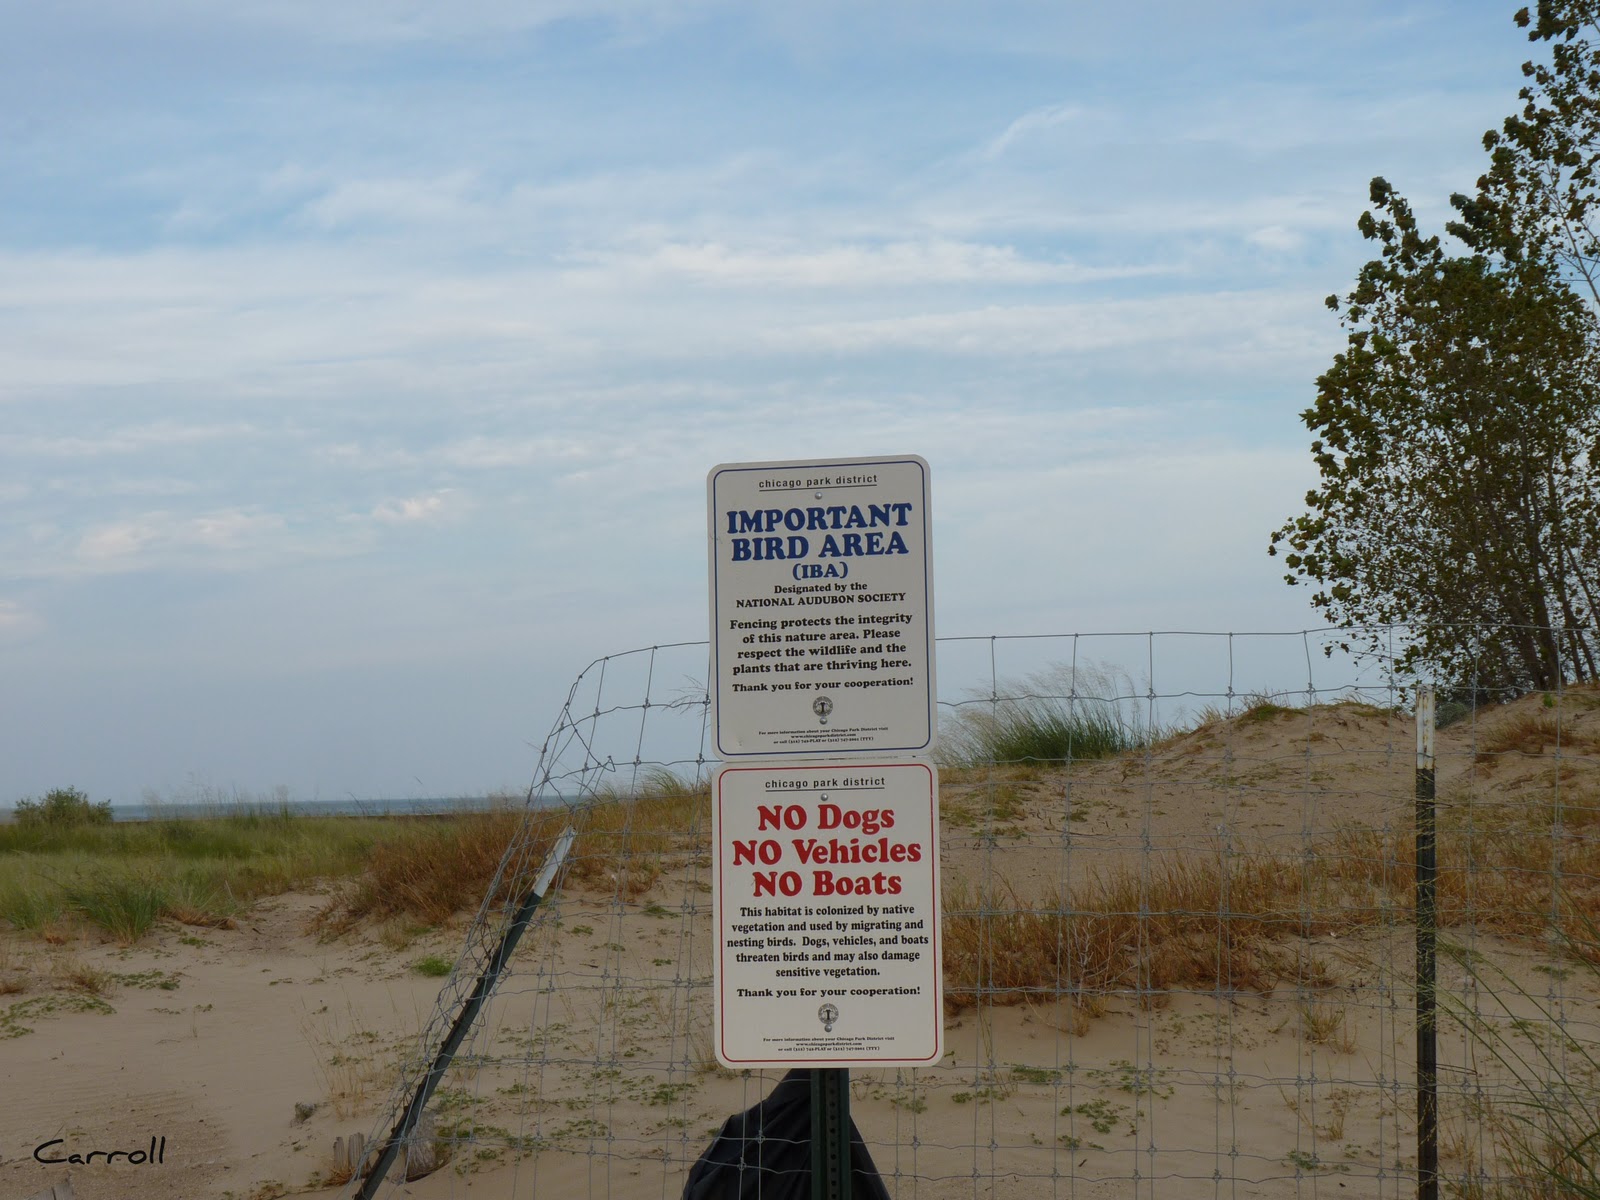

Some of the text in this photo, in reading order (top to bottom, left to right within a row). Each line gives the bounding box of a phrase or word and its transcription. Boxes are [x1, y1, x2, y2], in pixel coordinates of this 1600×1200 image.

[759, 475, 877, 489] chicago park district
[726, 502, 912, 534] IMPORTANT
[732, 531, 909, 561] BIRD AREA
[792, 561, 848, 580] (IBA)
[774, 582, 867, 595] Designated by the
[736, 593, 906, 608] NATIONAL AUDUBON SOCIETY
[730, 613, 912, 630] Fencing protects the integrity
[742, 629, 901, 644] of this nature area. Please
[737, 644, 906, 660] respect the wildlife and the
[733, 658, 912, 675] plants that are thriving here.
[732, 677, 914, 692] Thank you for your cooperation!
[765, 777, 885, 789] chicago park district
[757, 804, 895, 835] NO Dogs
[732, 837, 921, 865] NO Vehicles
[752, 870, 902, 897] NO Boats
[740, 905, 915, 917] This habitat is colonized by native
[732, 920, 924, 933] vegetation and used by migrating and
[727, 934, 929, 949] nesting birds. Dogs, vehicles, and boats
[736, 951, 920, 962] threaten birds and may also damage
[776, 966, 880, 978] sensitive vegetation.
[737, 986, 921, 998] Thank you for your cooperation!
